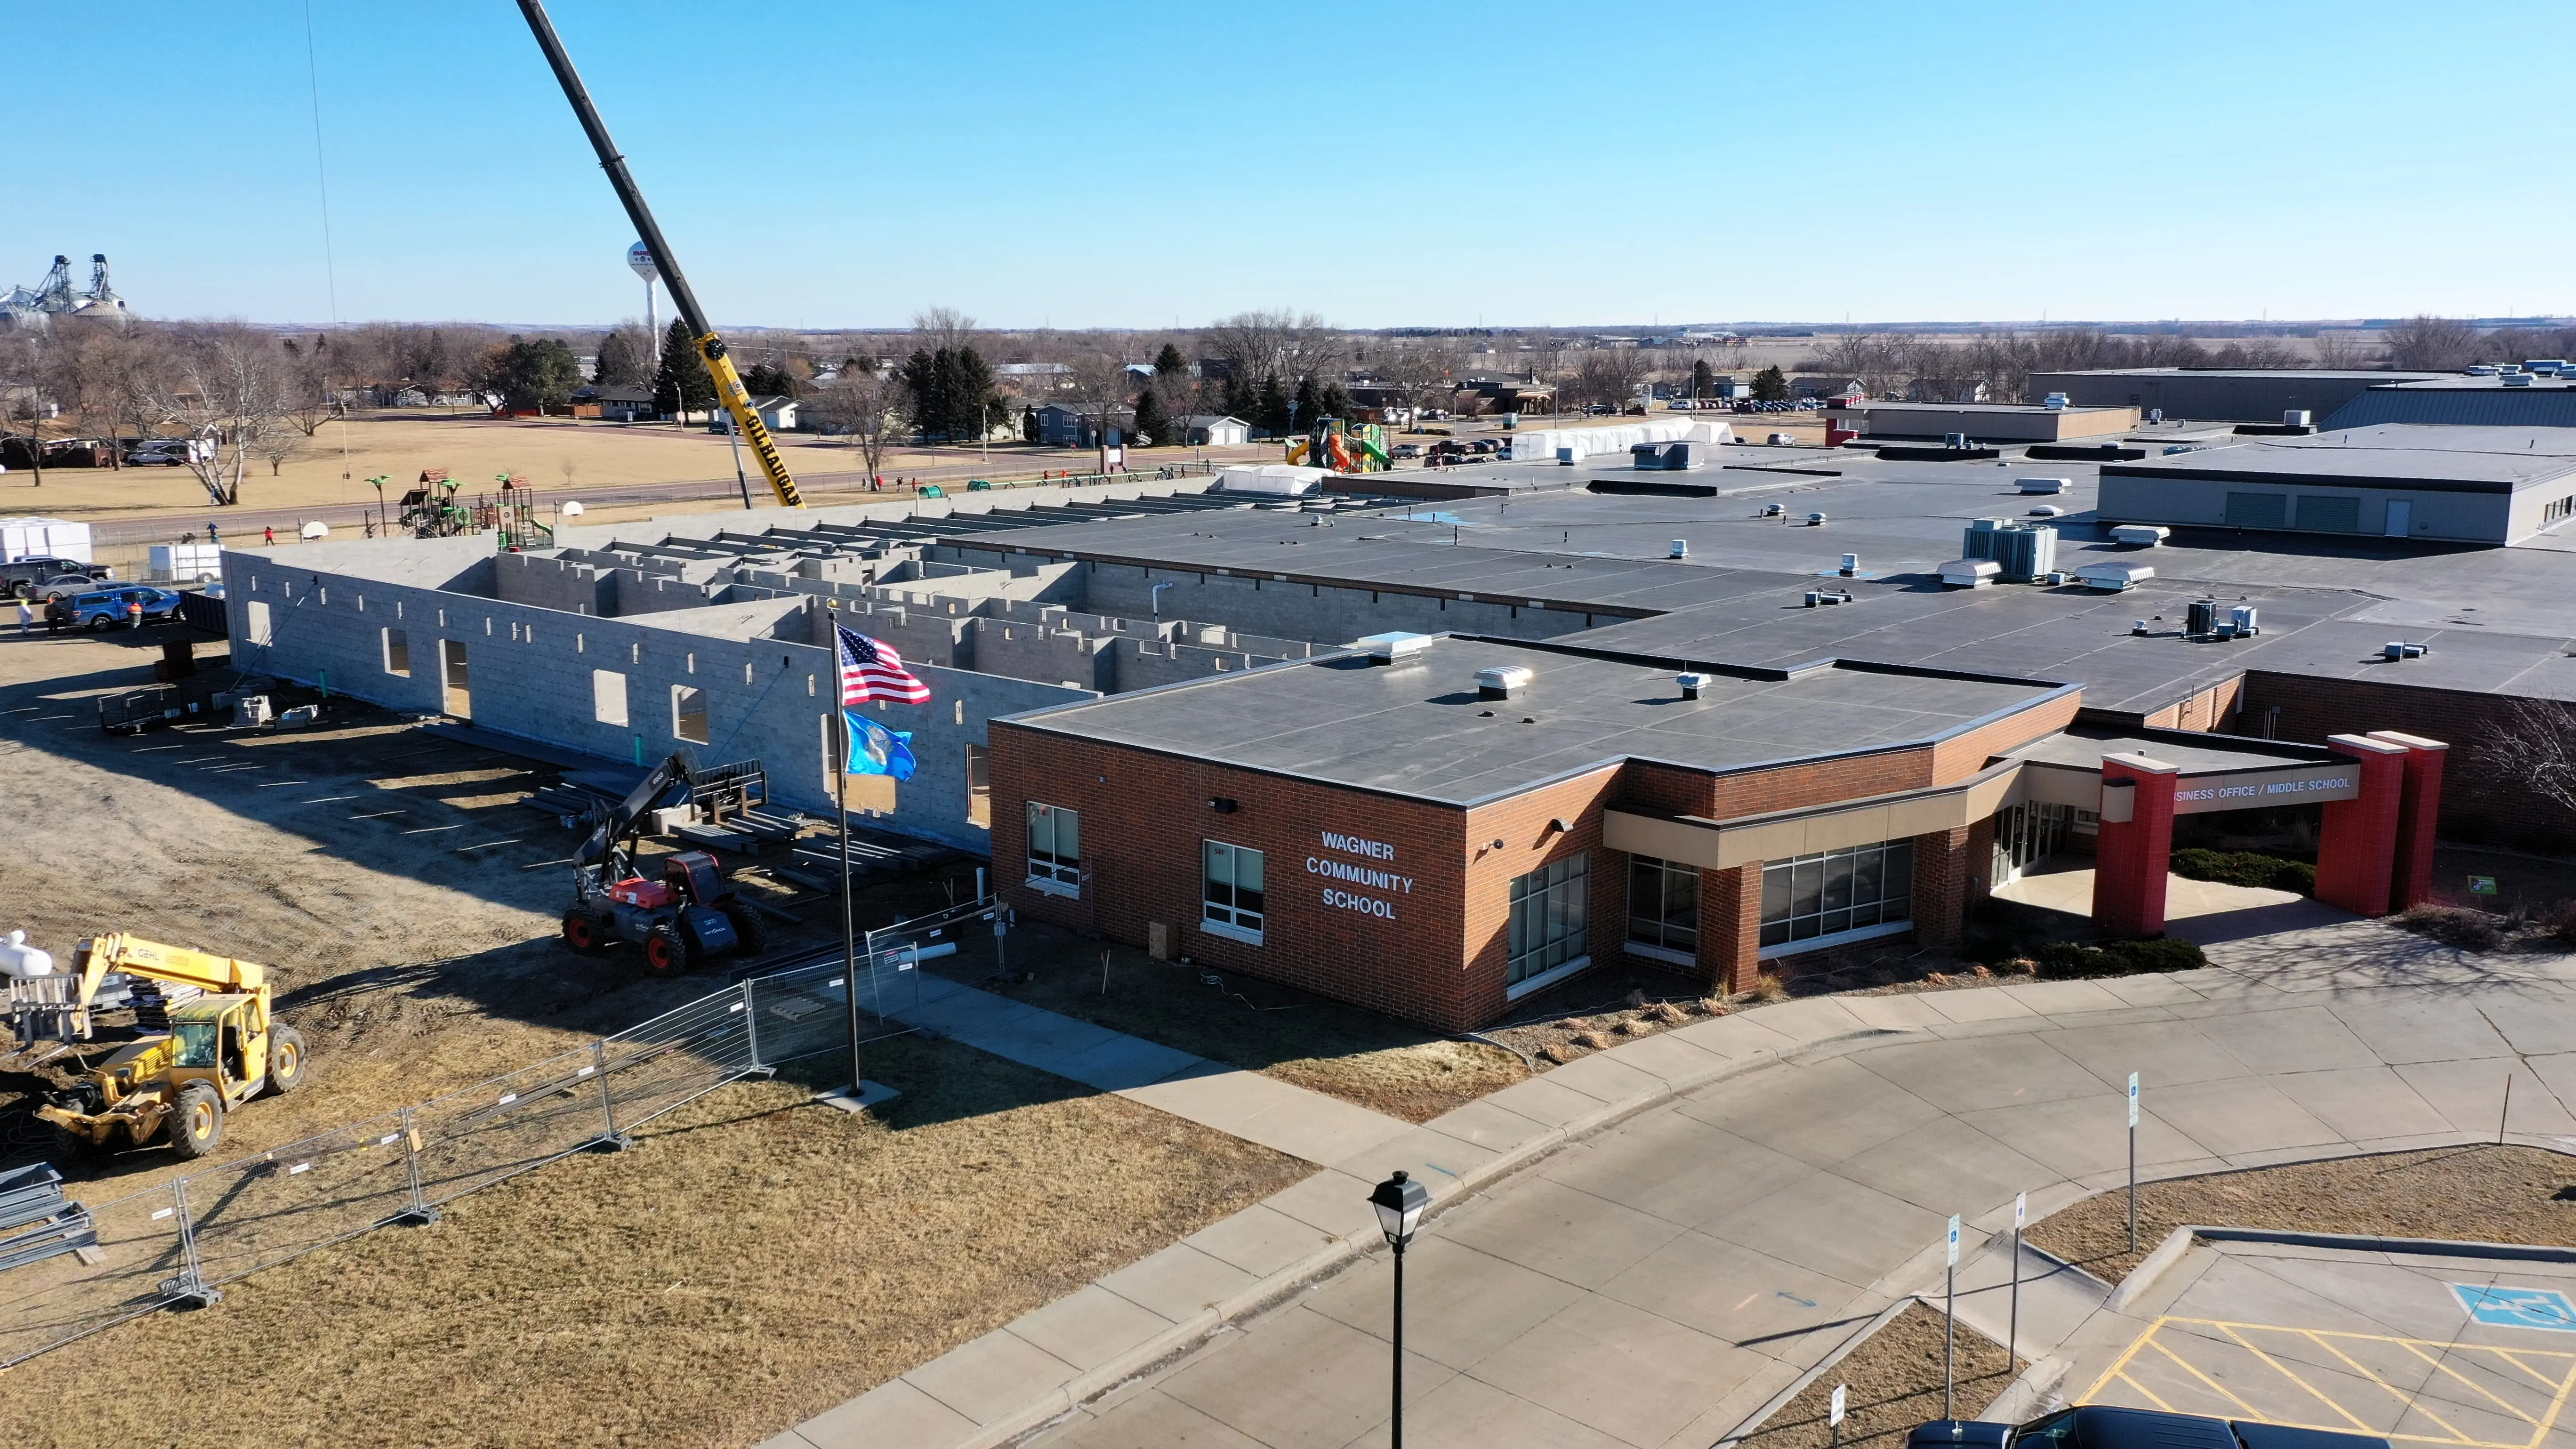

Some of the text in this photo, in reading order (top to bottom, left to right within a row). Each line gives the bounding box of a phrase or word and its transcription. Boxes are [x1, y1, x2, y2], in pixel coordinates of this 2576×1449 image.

[745, 415, 803, 507] GIL HAUGAN
[2174, 778, 2351, 802] SINESS OFFICE / MIDDLE SCHOOL
[1214, 848, 1224, 856] 541
[1321, 831, 1394, 861] WAGNER
[1306, 857, 1413, 894] COMMUNITY
[1323, 888, 1396, 920] SCHOOL
[138, 949, 160, 961] GEHL
